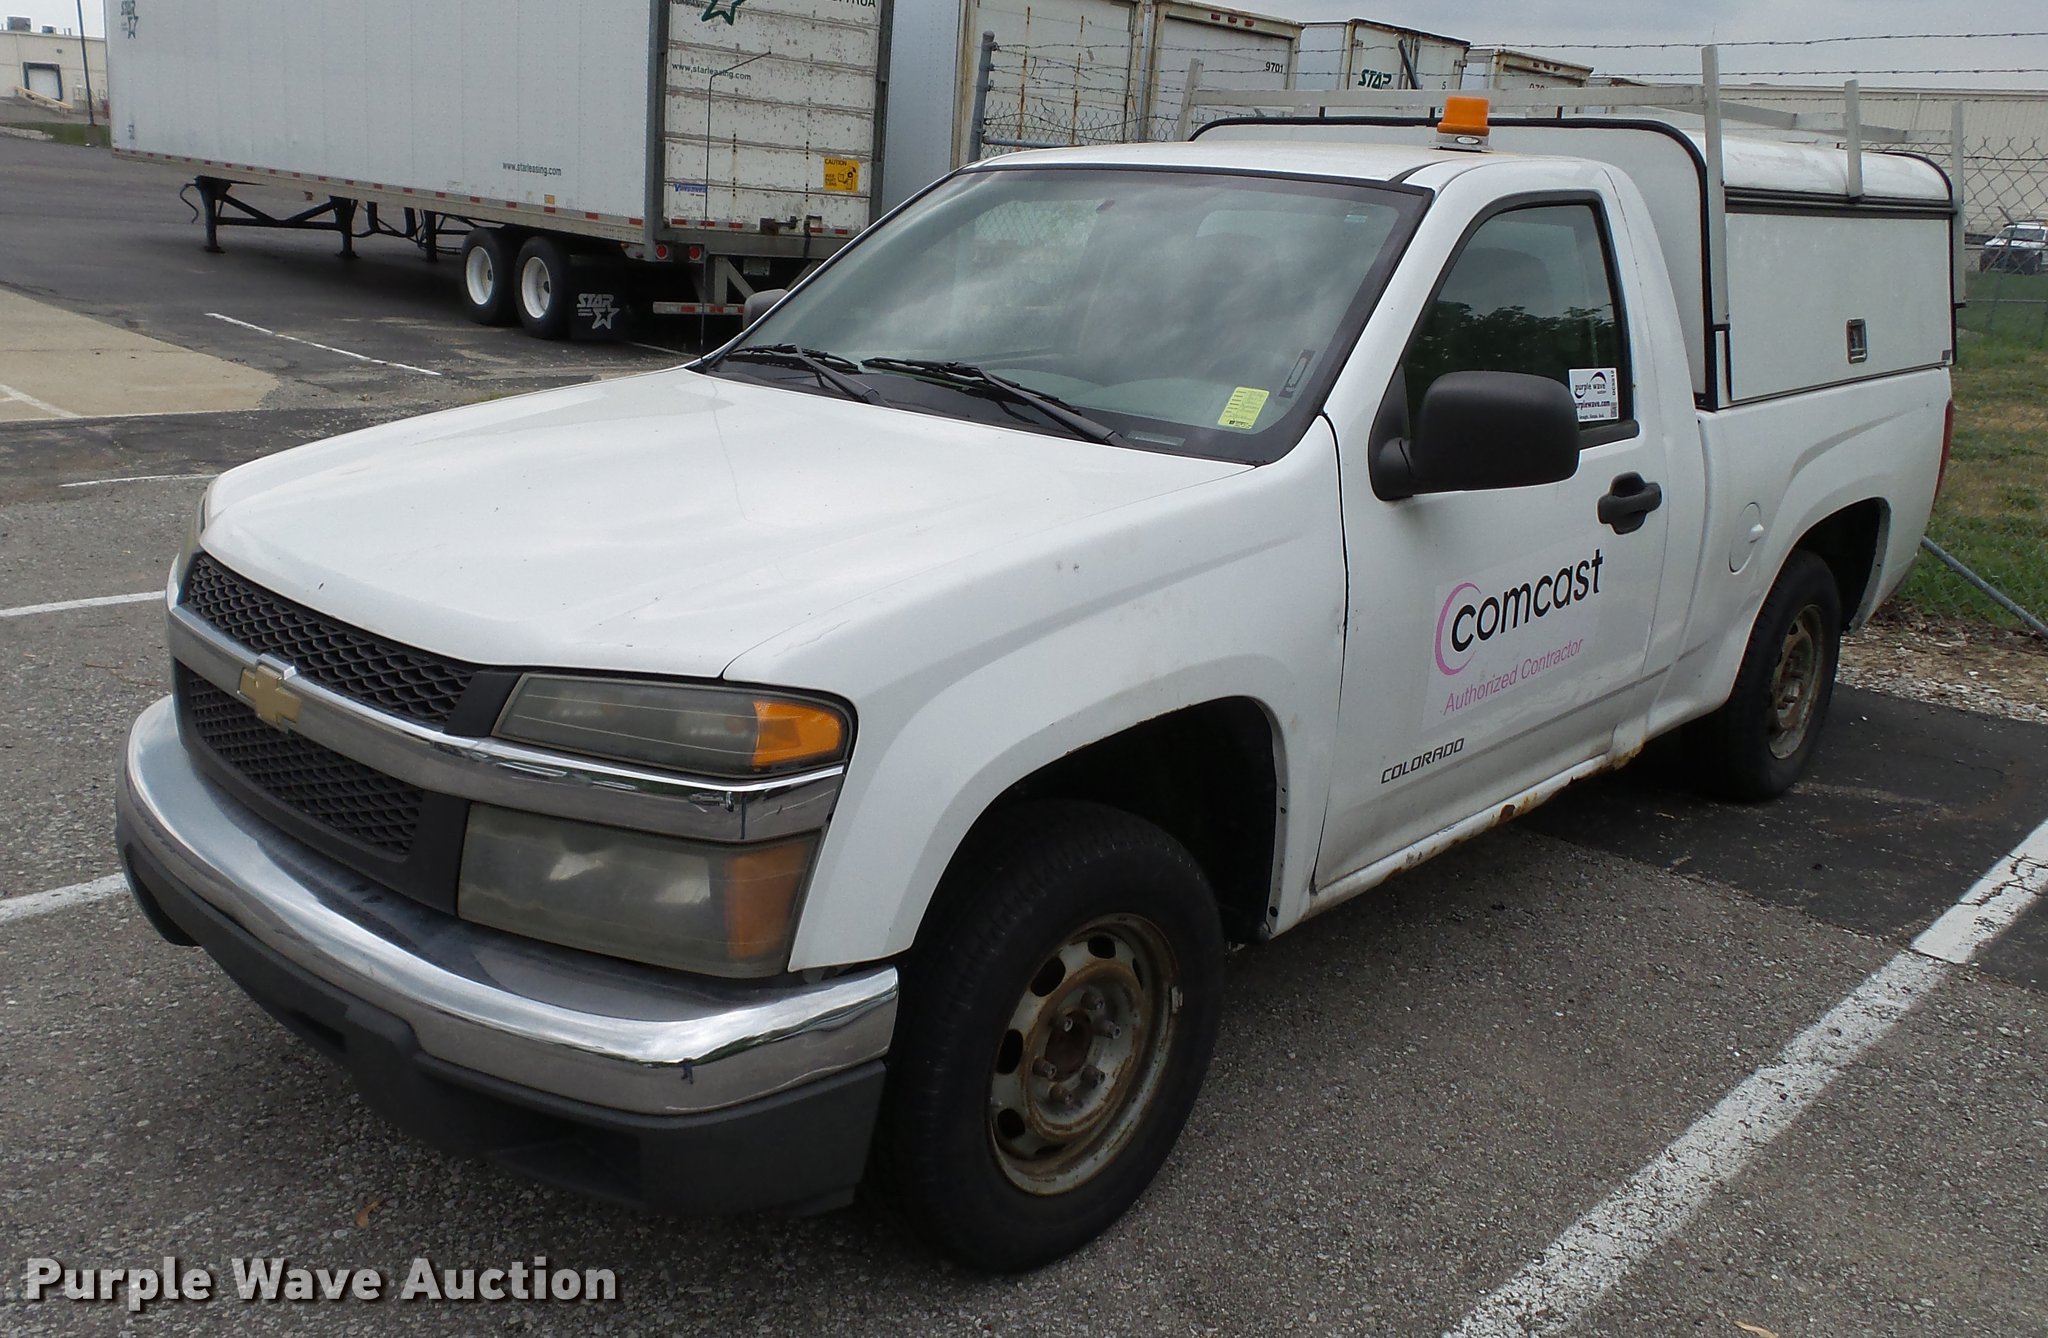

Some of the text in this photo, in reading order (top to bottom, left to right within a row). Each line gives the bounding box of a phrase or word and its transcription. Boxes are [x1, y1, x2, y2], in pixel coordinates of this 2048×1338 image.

[1265, 62, 1284, 74] 9701
[502, 162, 562, 177] www.starleasing.com
[577, 293, 614, 308] STAR
[1443, 638, 1584, 716] Authorized Contractor
[1380, 737, 1465, 785] COLORADO
